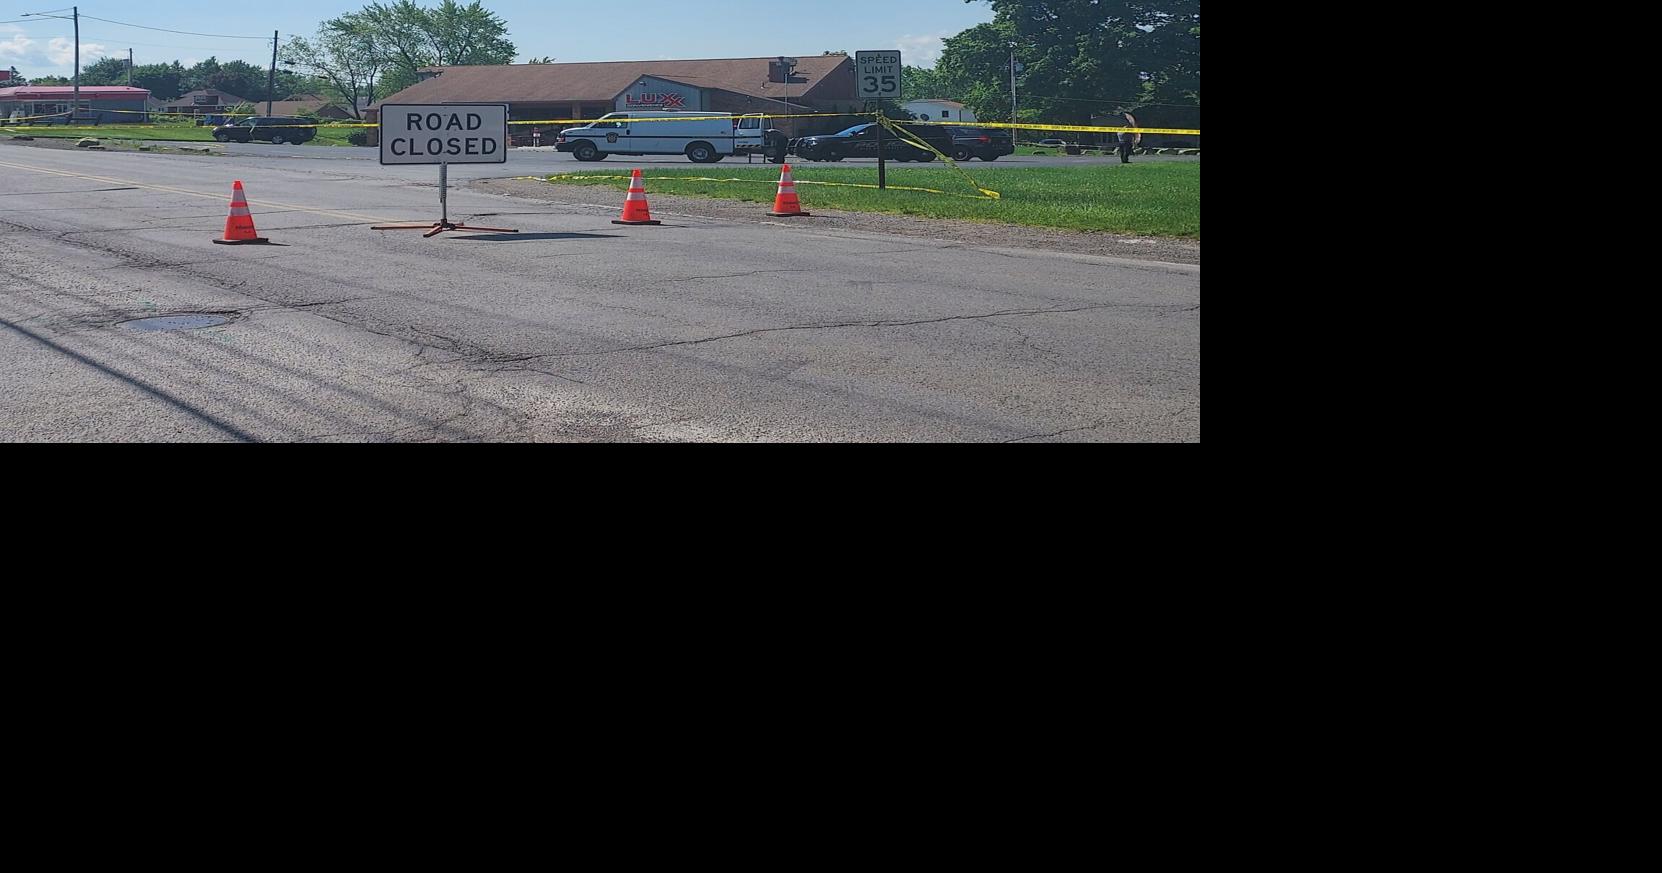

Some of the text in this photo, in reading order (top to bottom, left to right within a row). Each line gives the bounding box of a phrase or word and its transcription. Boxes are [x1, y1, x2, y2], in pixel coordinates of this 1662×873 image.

[860, 56, 897, 64] SPEED
[864, 65, 893, 74] LIMIT
[863, 75, 897, 93] 35
[406, 113, 482, 131] ROAD
[390, 137, 497, 156] CLOSED
